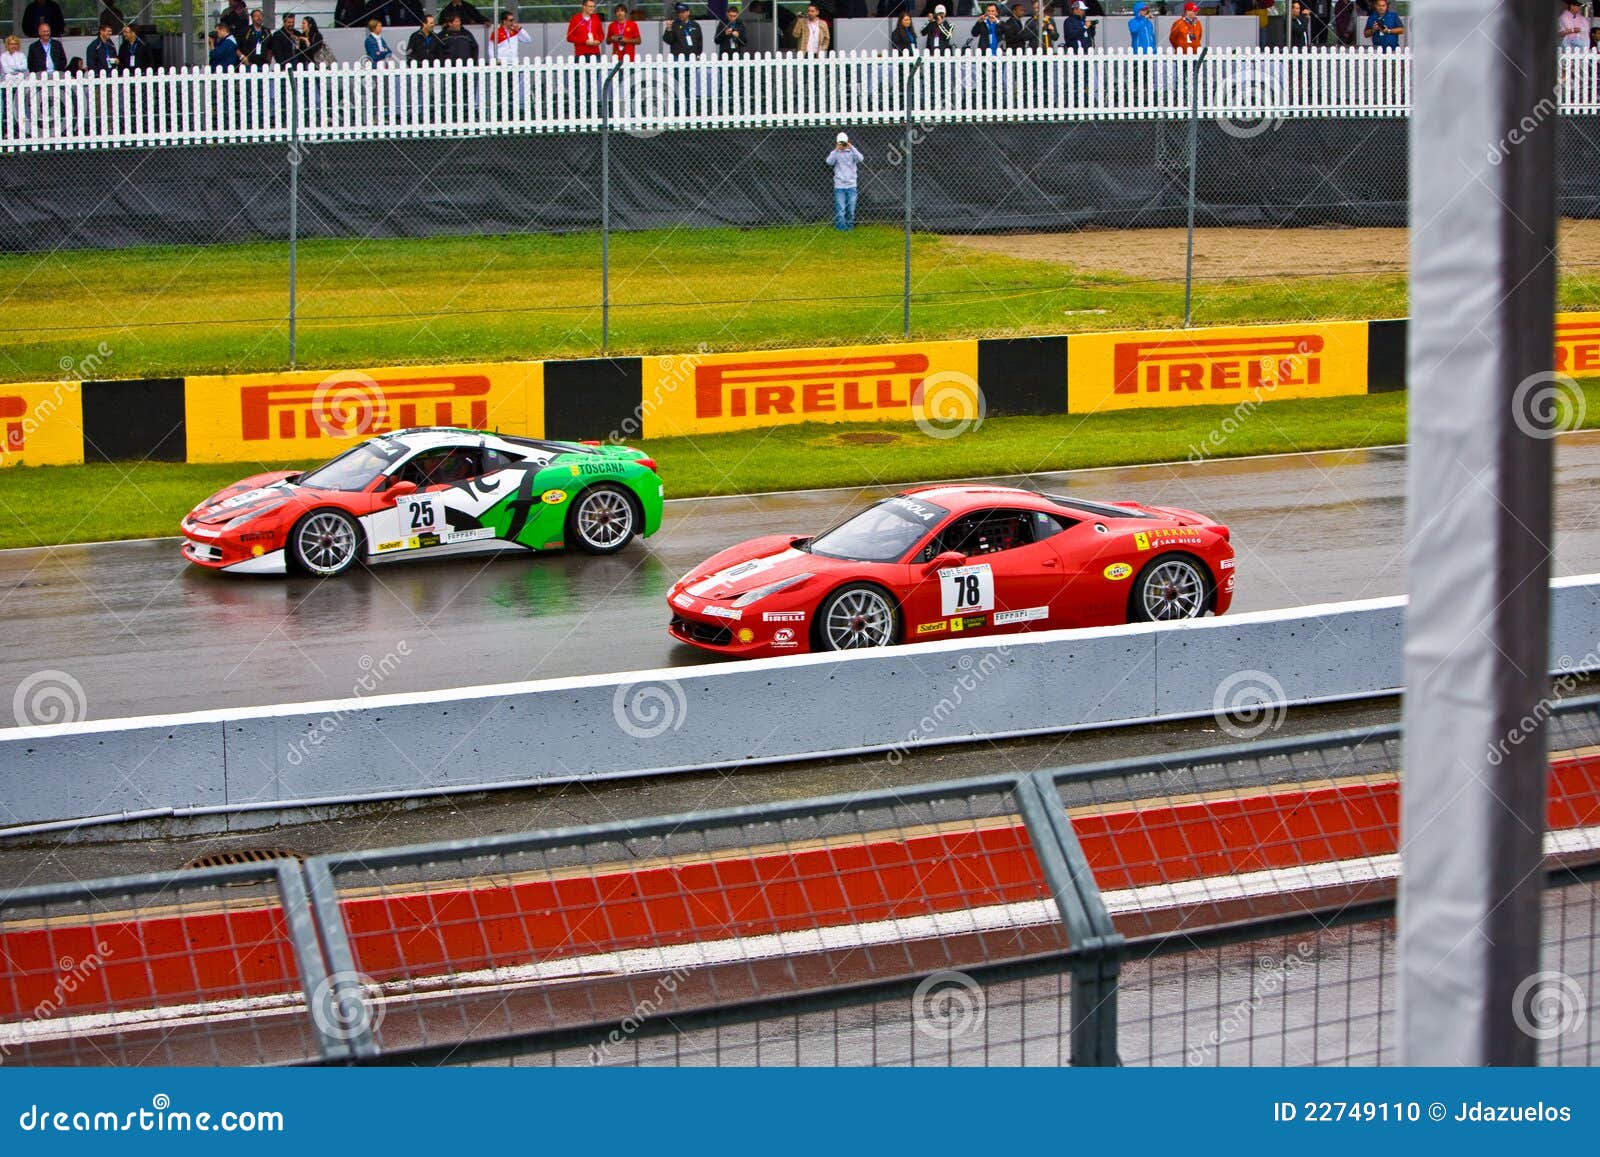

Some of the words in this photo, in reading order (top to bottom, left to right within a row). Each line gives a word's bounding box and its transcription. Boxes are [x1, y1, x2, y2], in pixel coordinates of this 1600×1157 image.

[1114, 334, 1325, 394] PIRELLI
[695, 353, 930, 418] PIRELLI
[241, 375, 491, 440] PIRELLI
[578, 463, 626, 475] TOSCANA
[409, 501, 435, 528] 25
[1147, 528, 1201, 538] FERRARI
[954, 575, 980, 607] 78
[762, 611, 806, 622] PIRELLI
